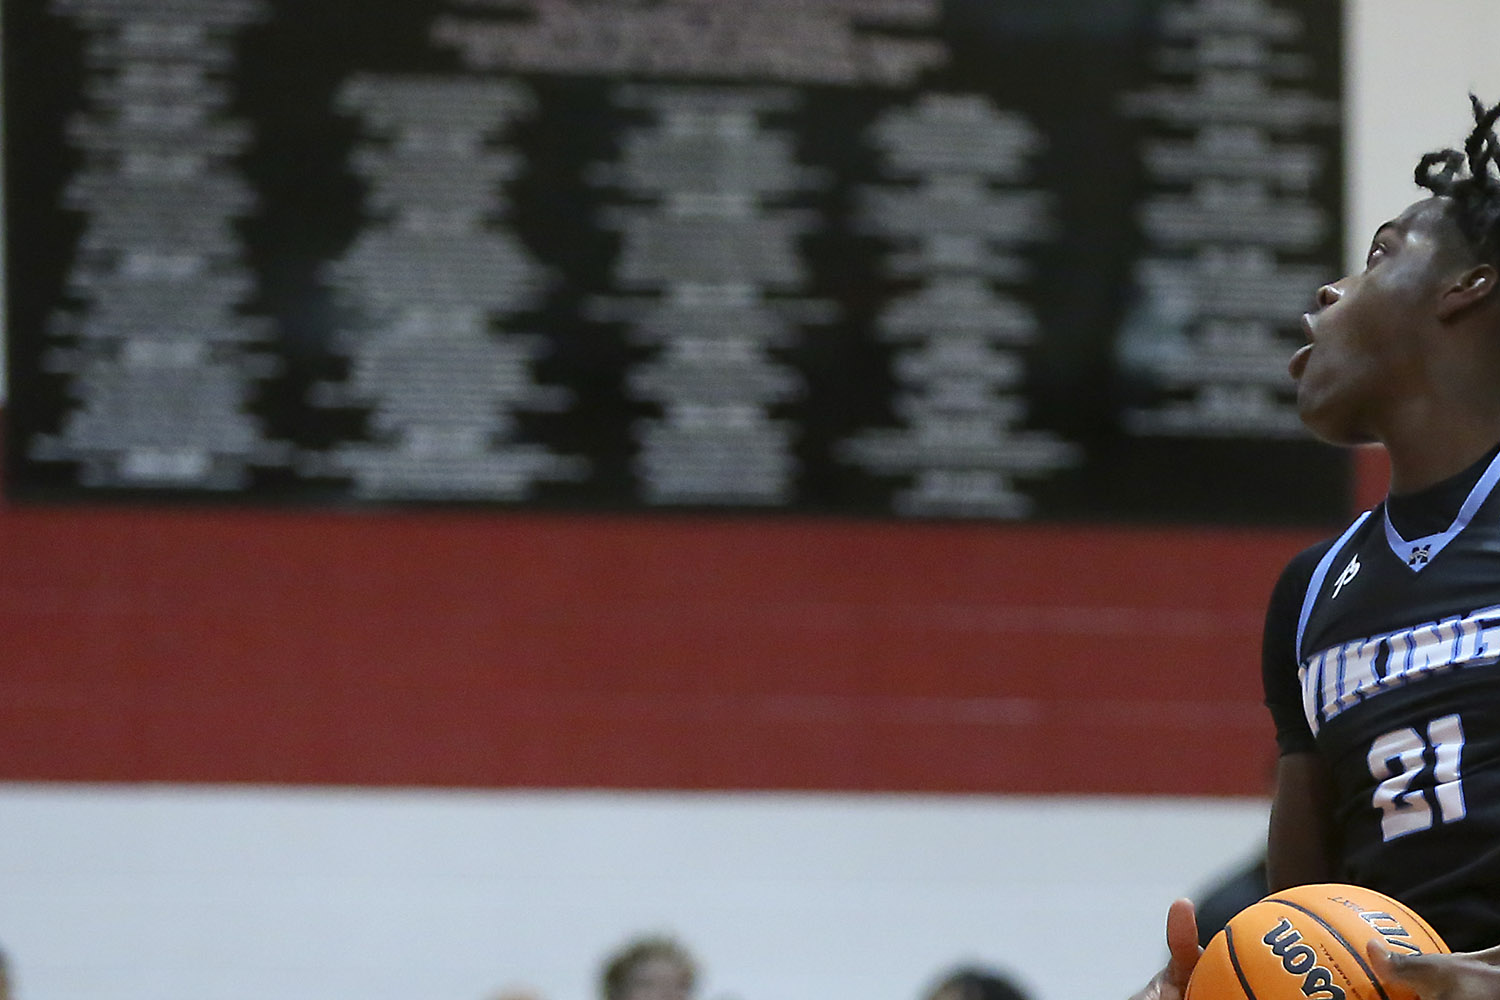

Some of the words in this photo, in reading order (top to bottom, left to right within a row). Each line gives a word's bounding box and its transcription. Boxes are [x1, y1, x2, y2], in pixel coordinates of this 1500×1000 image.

[1367, 713, 1467, 842] 21
[1319, 943, 1335, 963] BALL
[1359, 911, 1423, 957] VO
